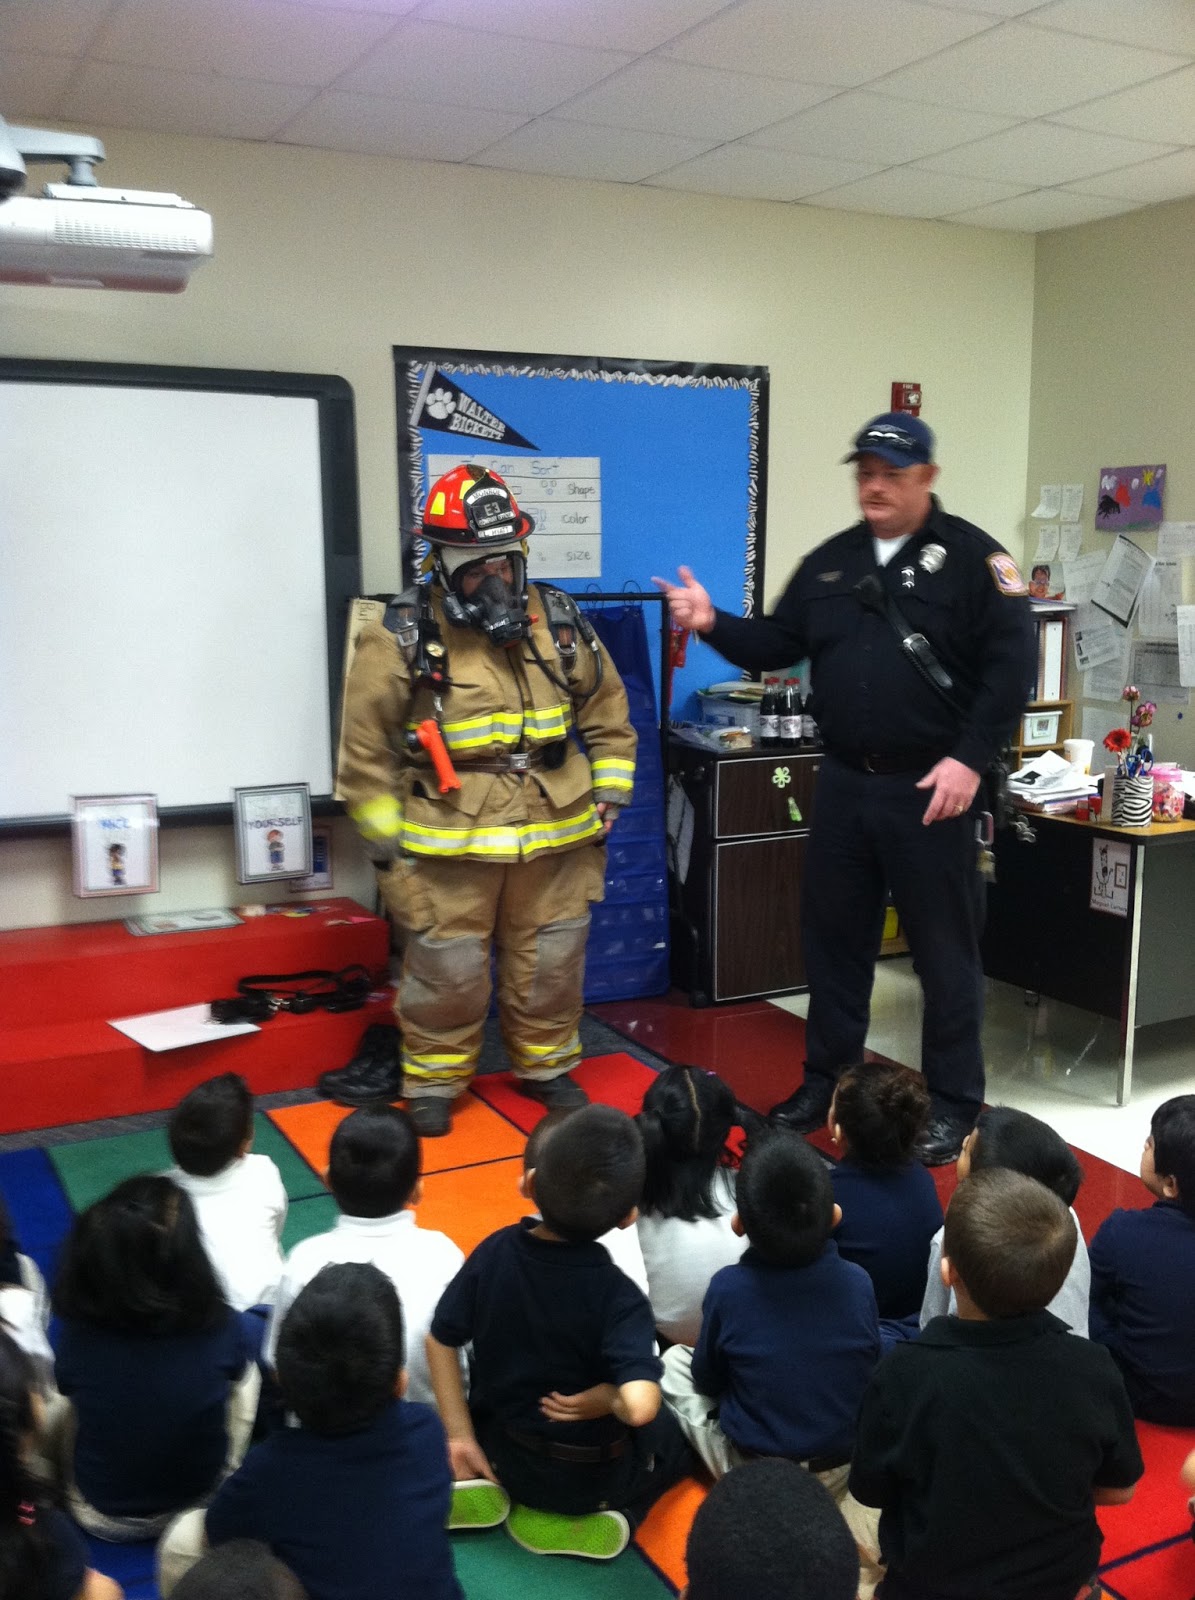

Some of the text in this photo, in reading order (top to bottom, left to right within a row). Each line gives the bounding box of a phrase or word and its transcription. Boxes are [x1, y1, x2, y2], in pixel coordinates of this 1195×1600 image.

[457, 392, 506, 433] WALTER
[449, 413, 505, 440] BICKETT
[490, 460, 560, 475] Can Sort
[484, 502, 501, 517] E3
